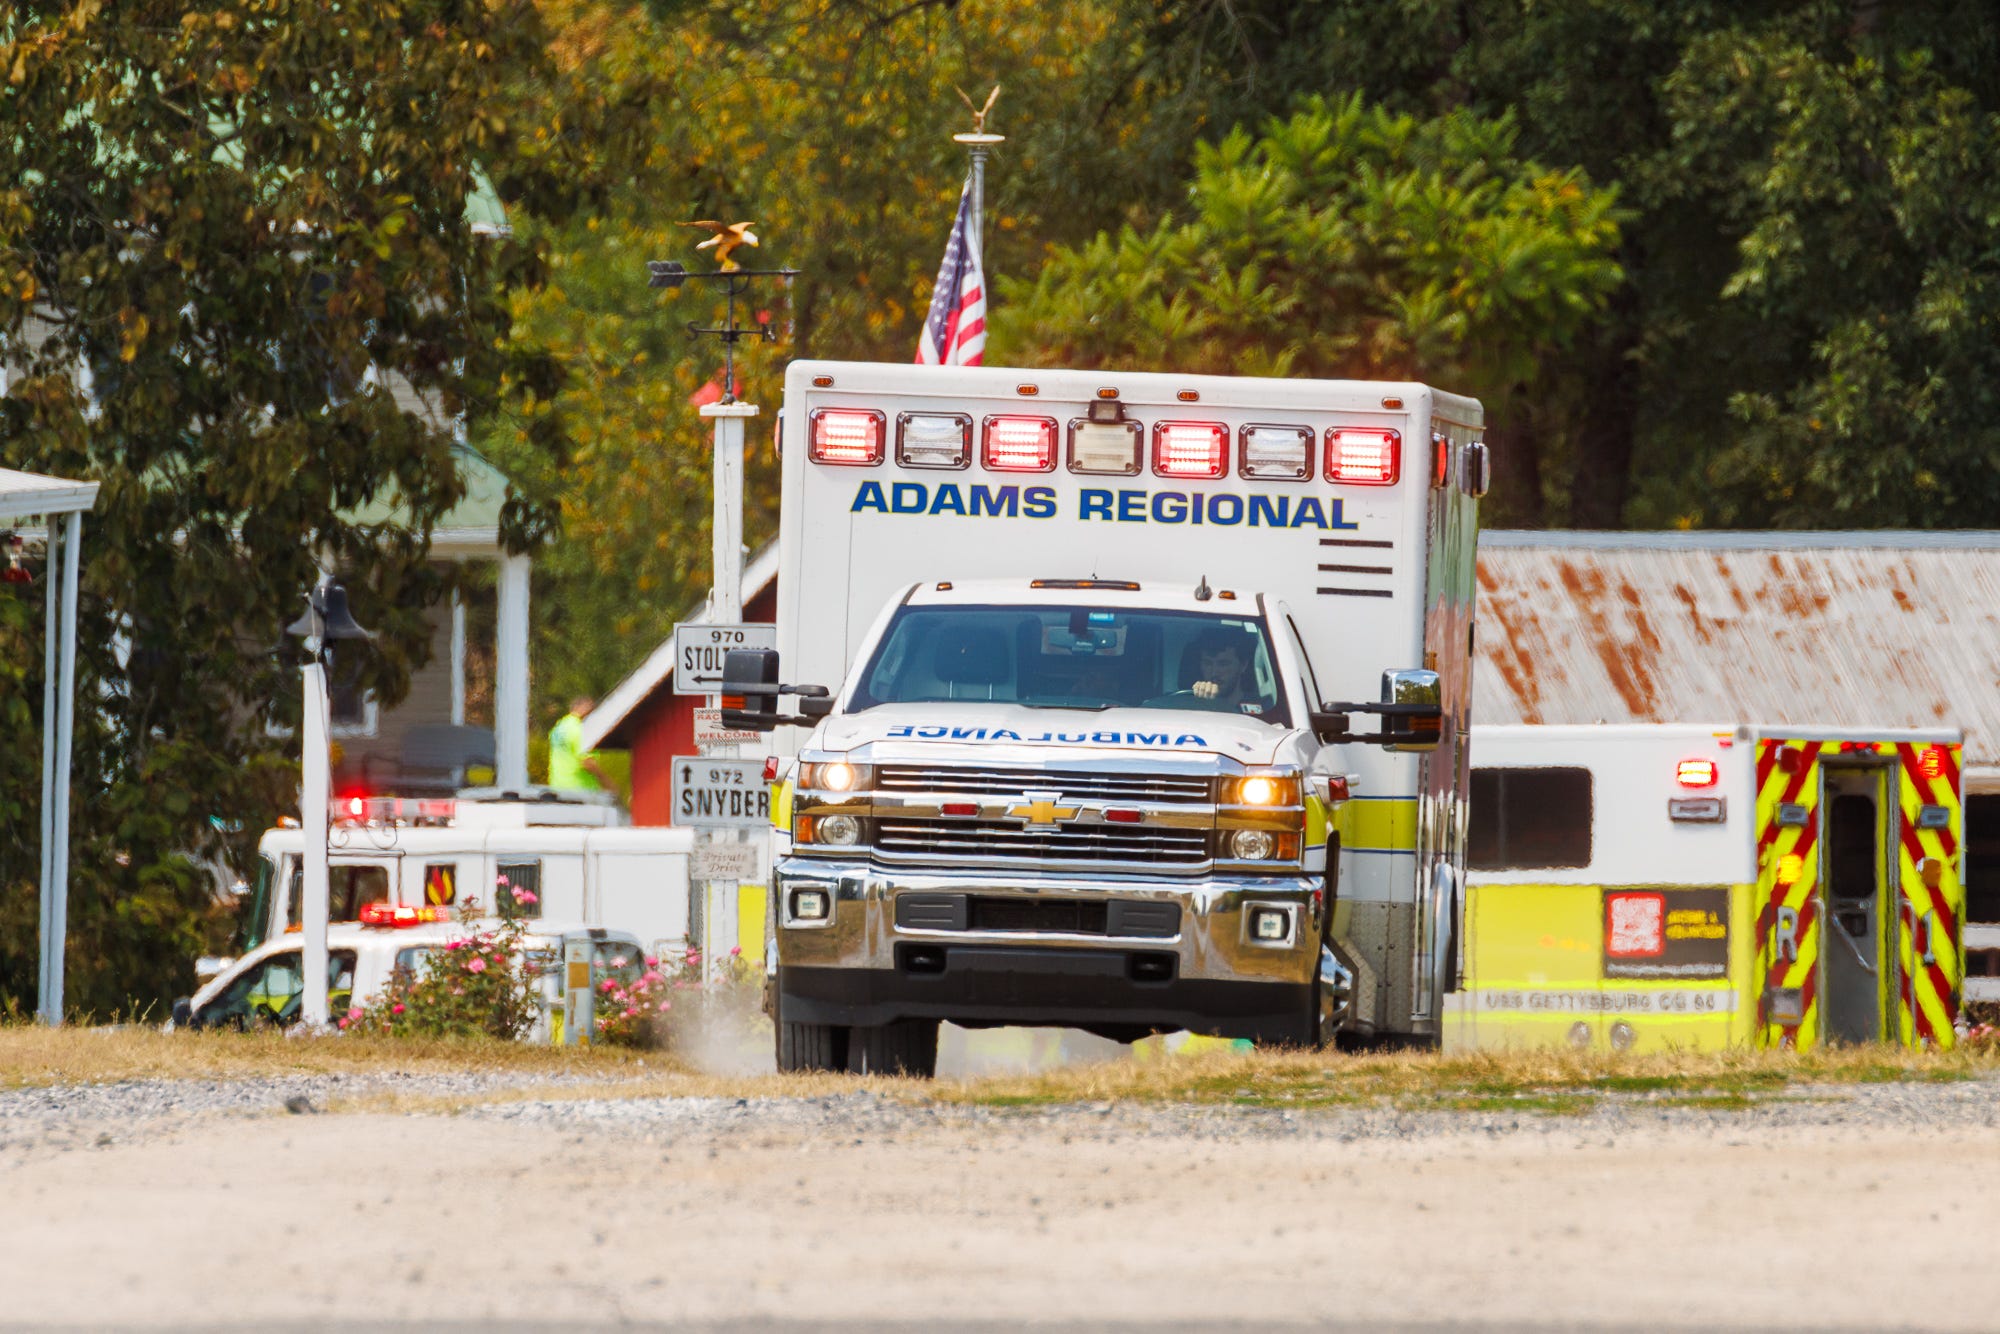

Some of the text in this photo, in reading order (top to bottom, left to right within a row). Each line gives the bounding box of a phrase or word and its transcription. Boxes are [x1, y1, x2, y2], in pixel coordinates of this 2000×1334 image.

[850, 481, 1359, 530] ADAMS REGIONAL
[711, 631, 744, 643] 970
[697, 731, 759, 739] WELCOME
[709, 769, 744, 784] 972
[682, 788, 770, 817] SNYDER
[708, 862, 742, 873] Drive
[1775, 905, 1799, 961] R
[1529, 991, 1651, 1011] GETTYSBURG
